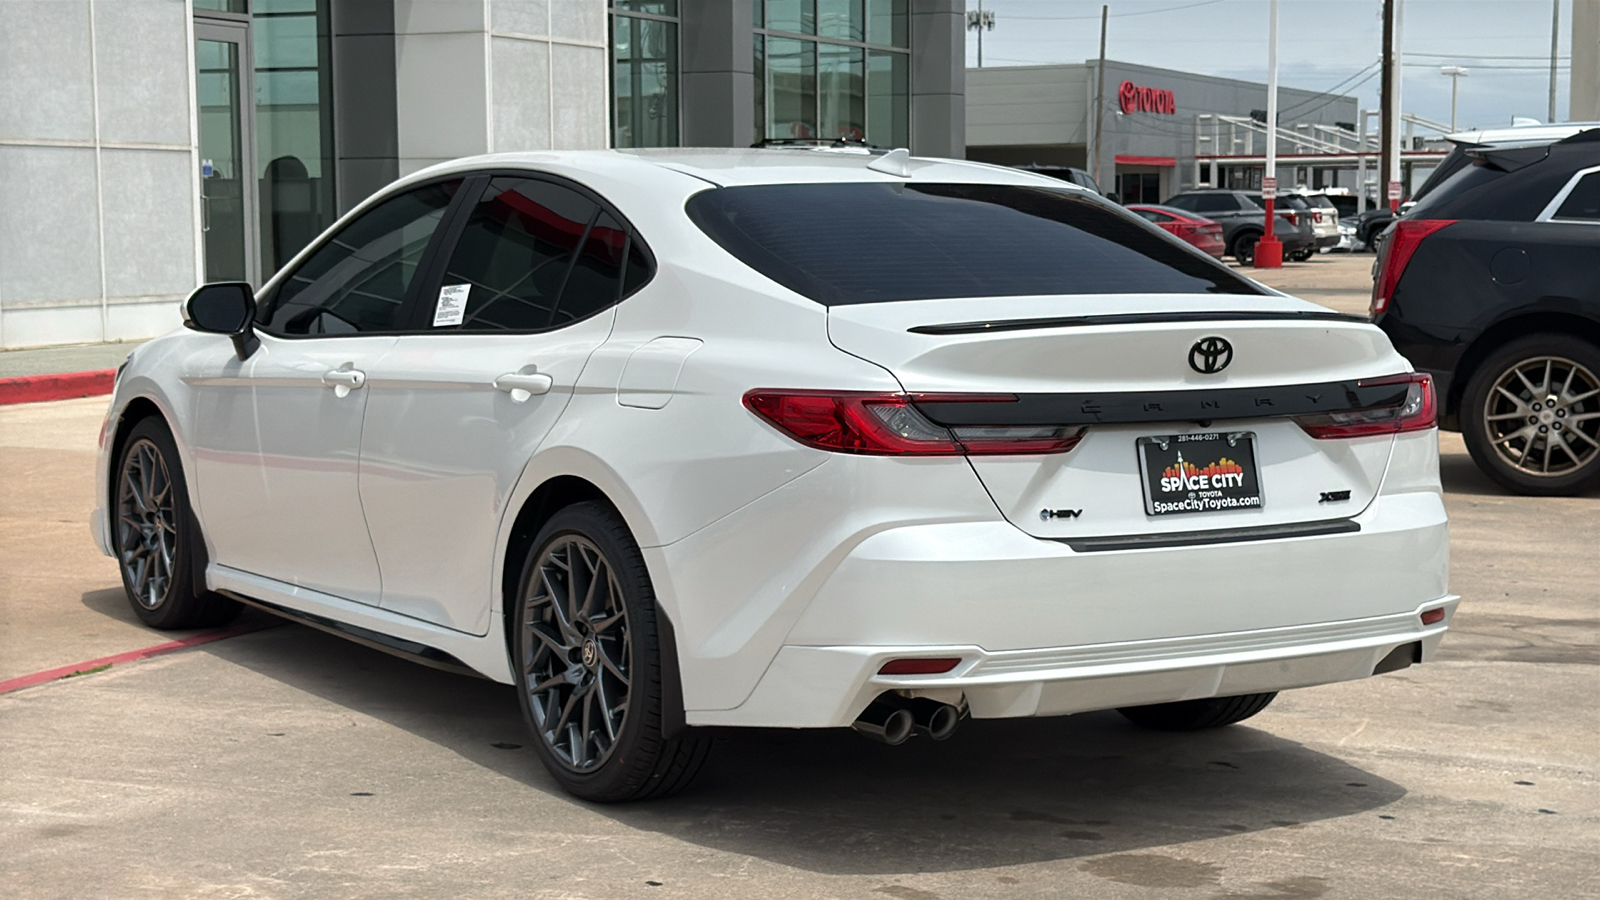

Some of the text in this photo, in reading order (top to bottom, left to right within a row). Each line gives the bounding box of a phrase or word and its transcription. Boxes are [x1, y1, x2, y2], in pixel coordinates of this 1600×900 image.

[1135, 86, 1176, 115] TOYOTA
[1160, 465, 1244, 492] SPACE CITY
[1154, 496, 1259, 513] SpaceCityToyota.com
[1198, 490, 1223, 498] TOYOTA
